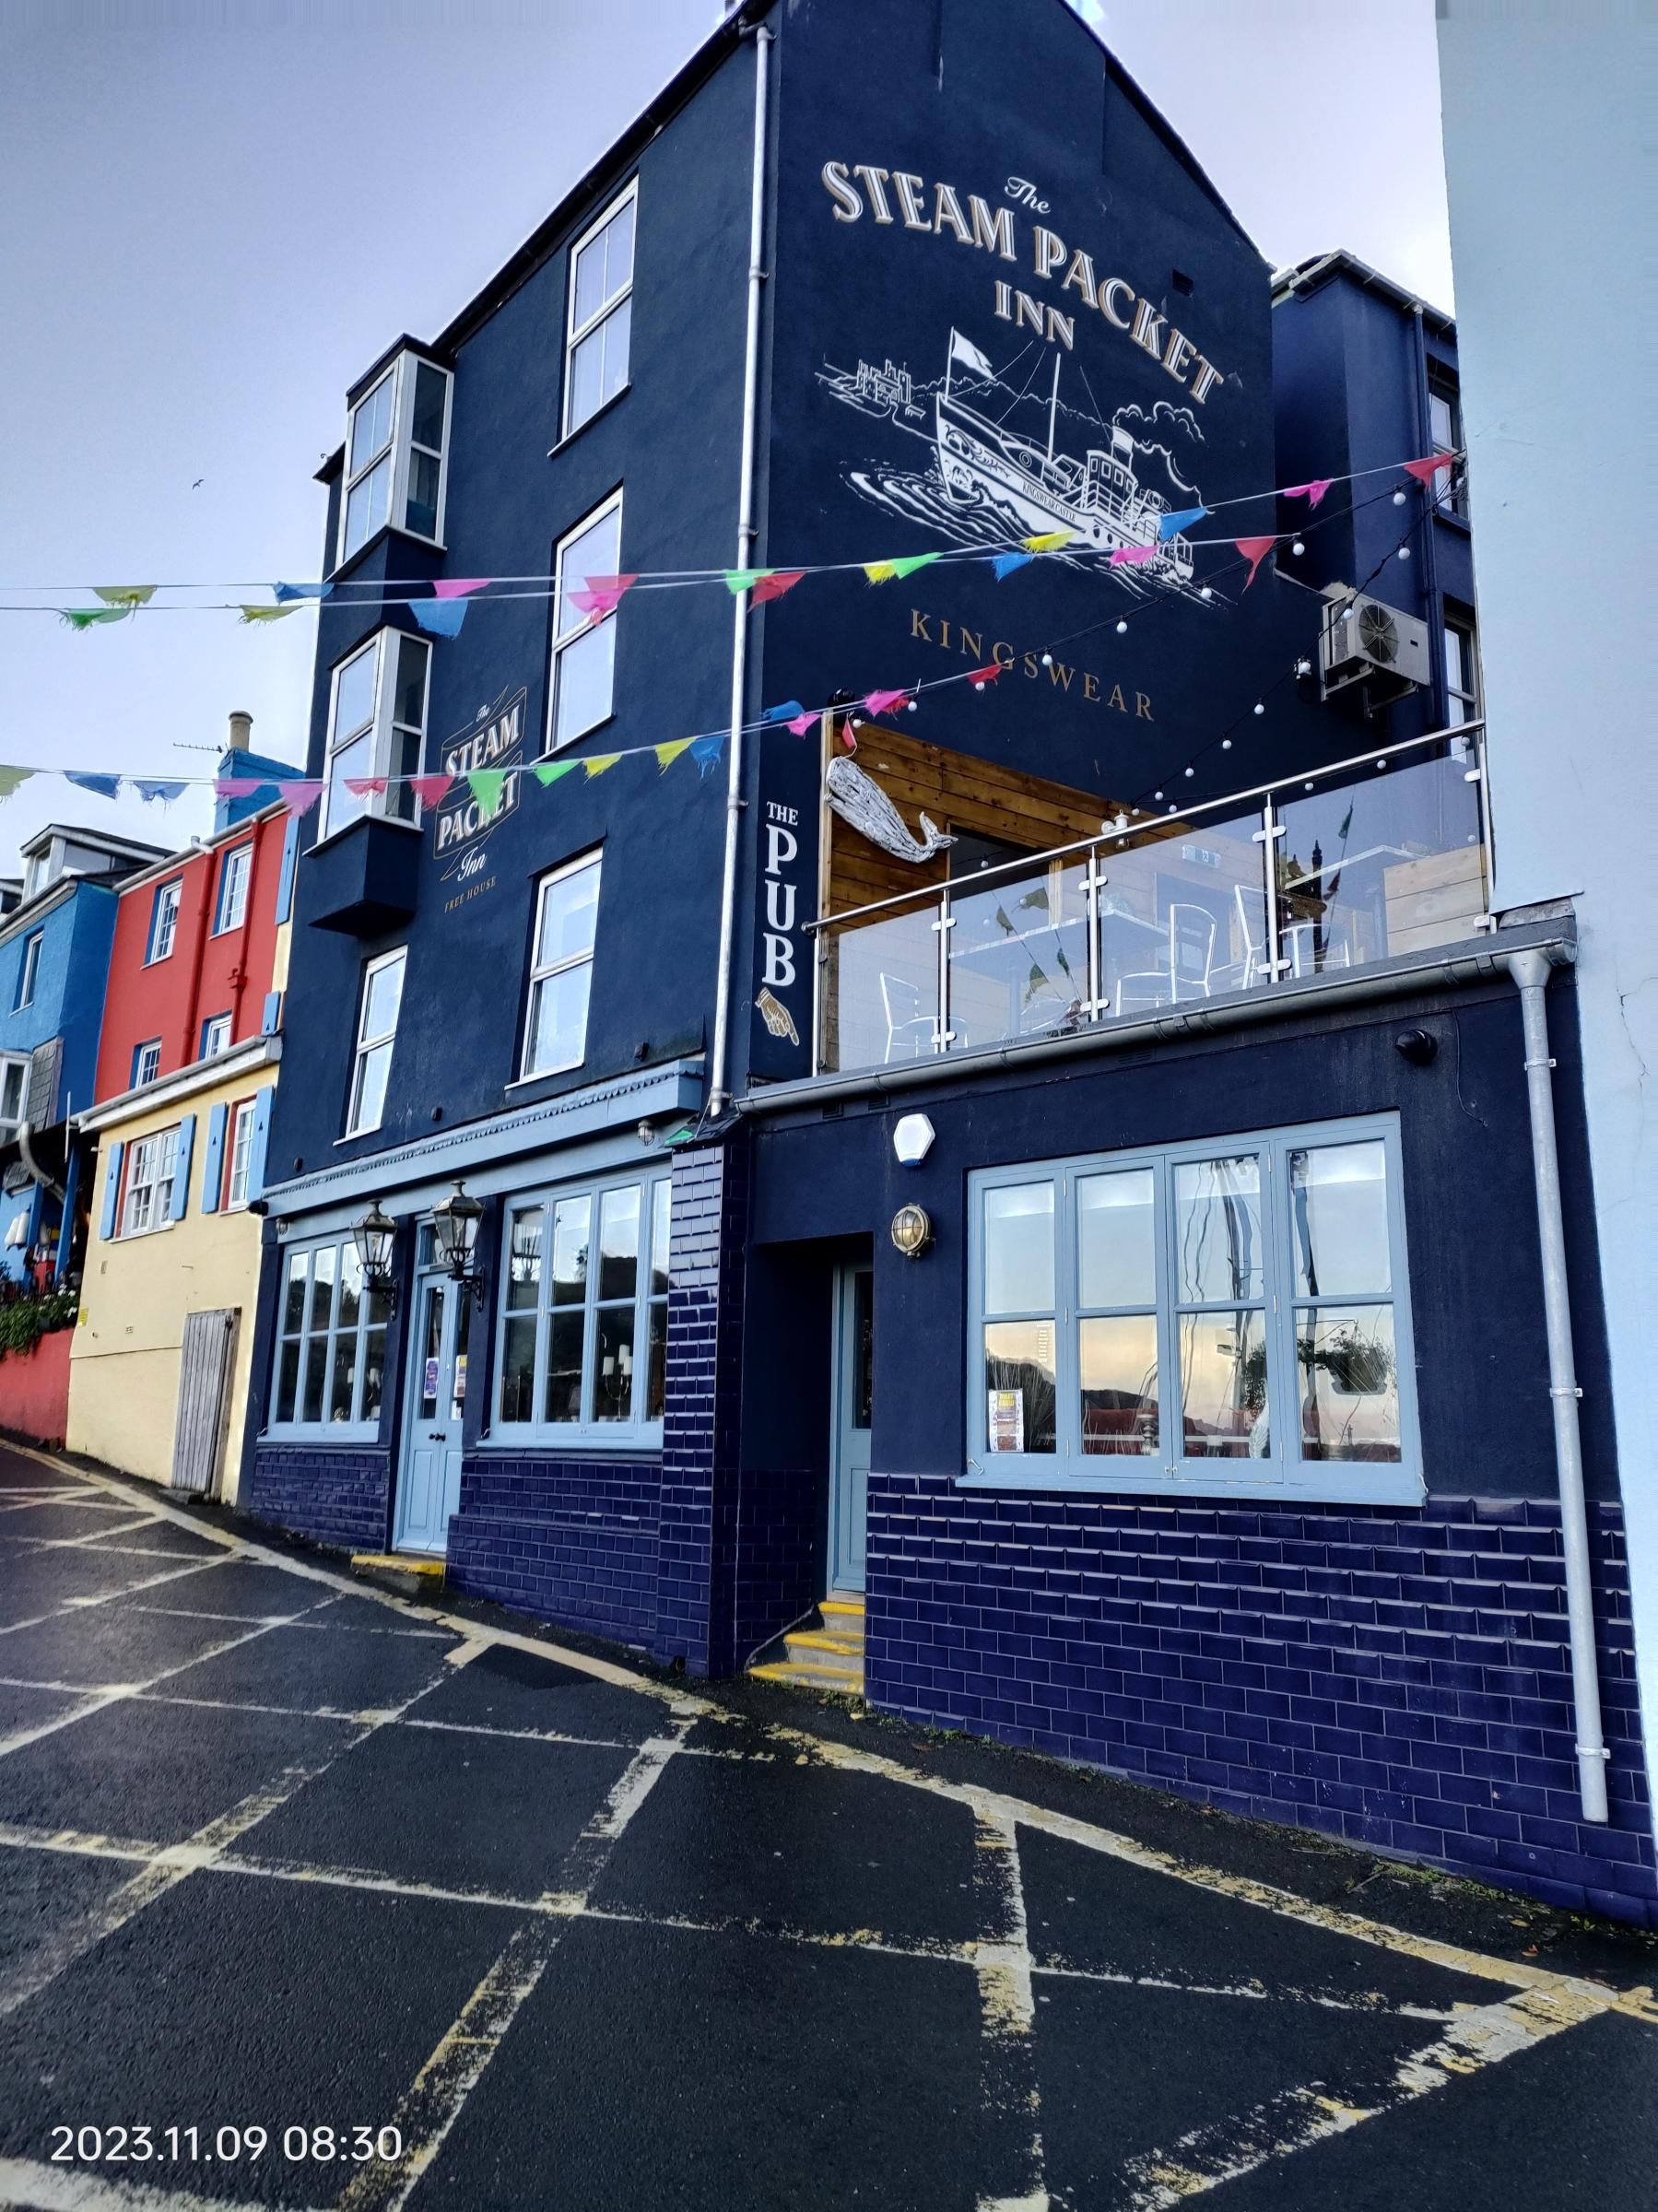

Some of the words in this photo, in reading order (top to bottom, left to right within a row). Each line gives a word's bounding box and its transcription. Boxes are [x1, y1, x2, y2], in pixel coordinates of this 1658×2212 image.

[1005, 176, 1052, 215] The
[821, 160, 1017, 262] STEAM
[1032, 225, 1224, 405] PACKET
[994, 279, 1076, 350] INN
[910, 607, 1154, 722] KINGSWEAR
[476, 704, 490, 722] The
[445, 704, 520, 780] STEAM
[767, 801, 799, 826] THE
[457, 846, 488, 882] Inn
[444, 894, 465, 914] FREE
[466, 876, 497, 900] HOUSE
[761, 823, 798, 987] PUB
